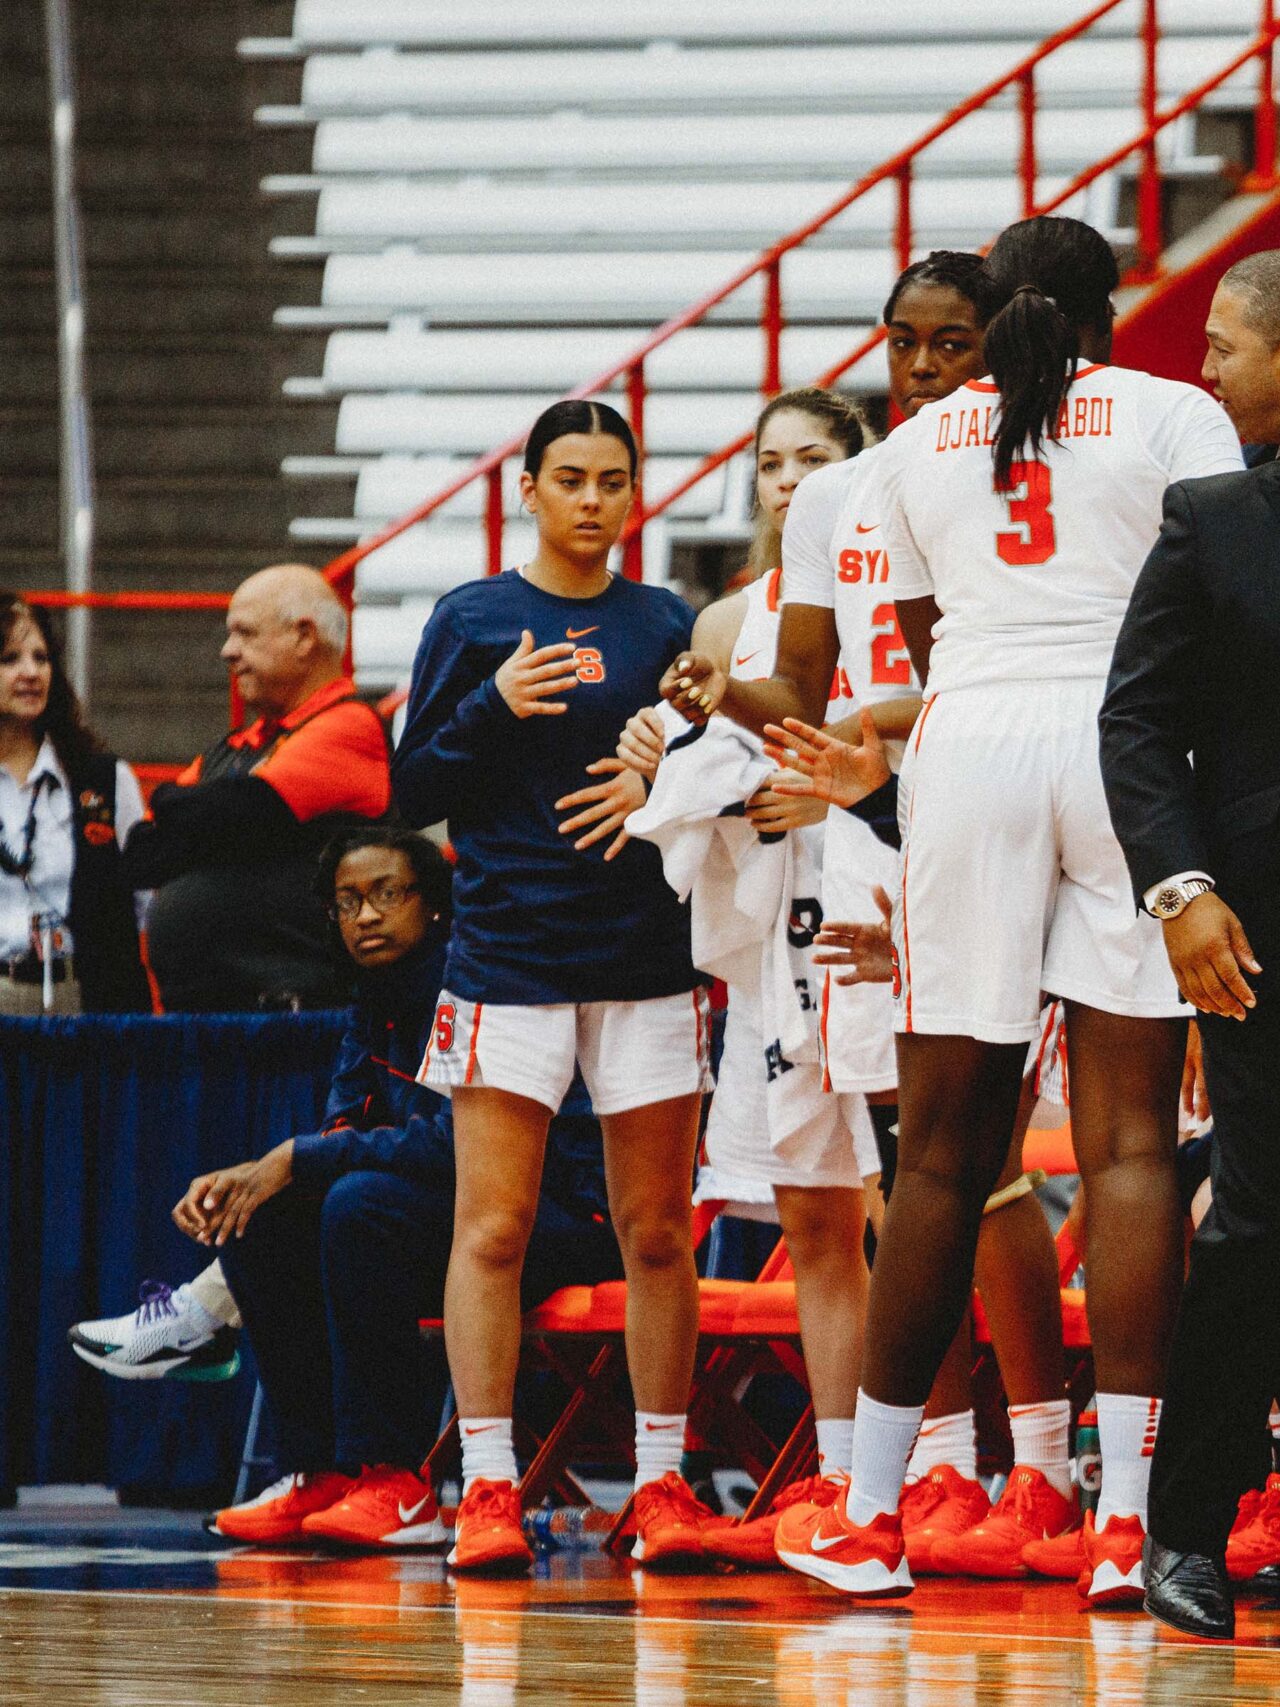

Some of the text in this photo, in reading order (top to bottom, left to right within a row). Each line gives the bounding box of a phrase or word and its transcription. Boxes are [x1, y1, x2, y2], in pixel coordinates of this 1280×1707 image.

[992, 459, 1057, 567] 3
[573, 647, 606, 683] S
[436, 1002, 457, 1053] S
